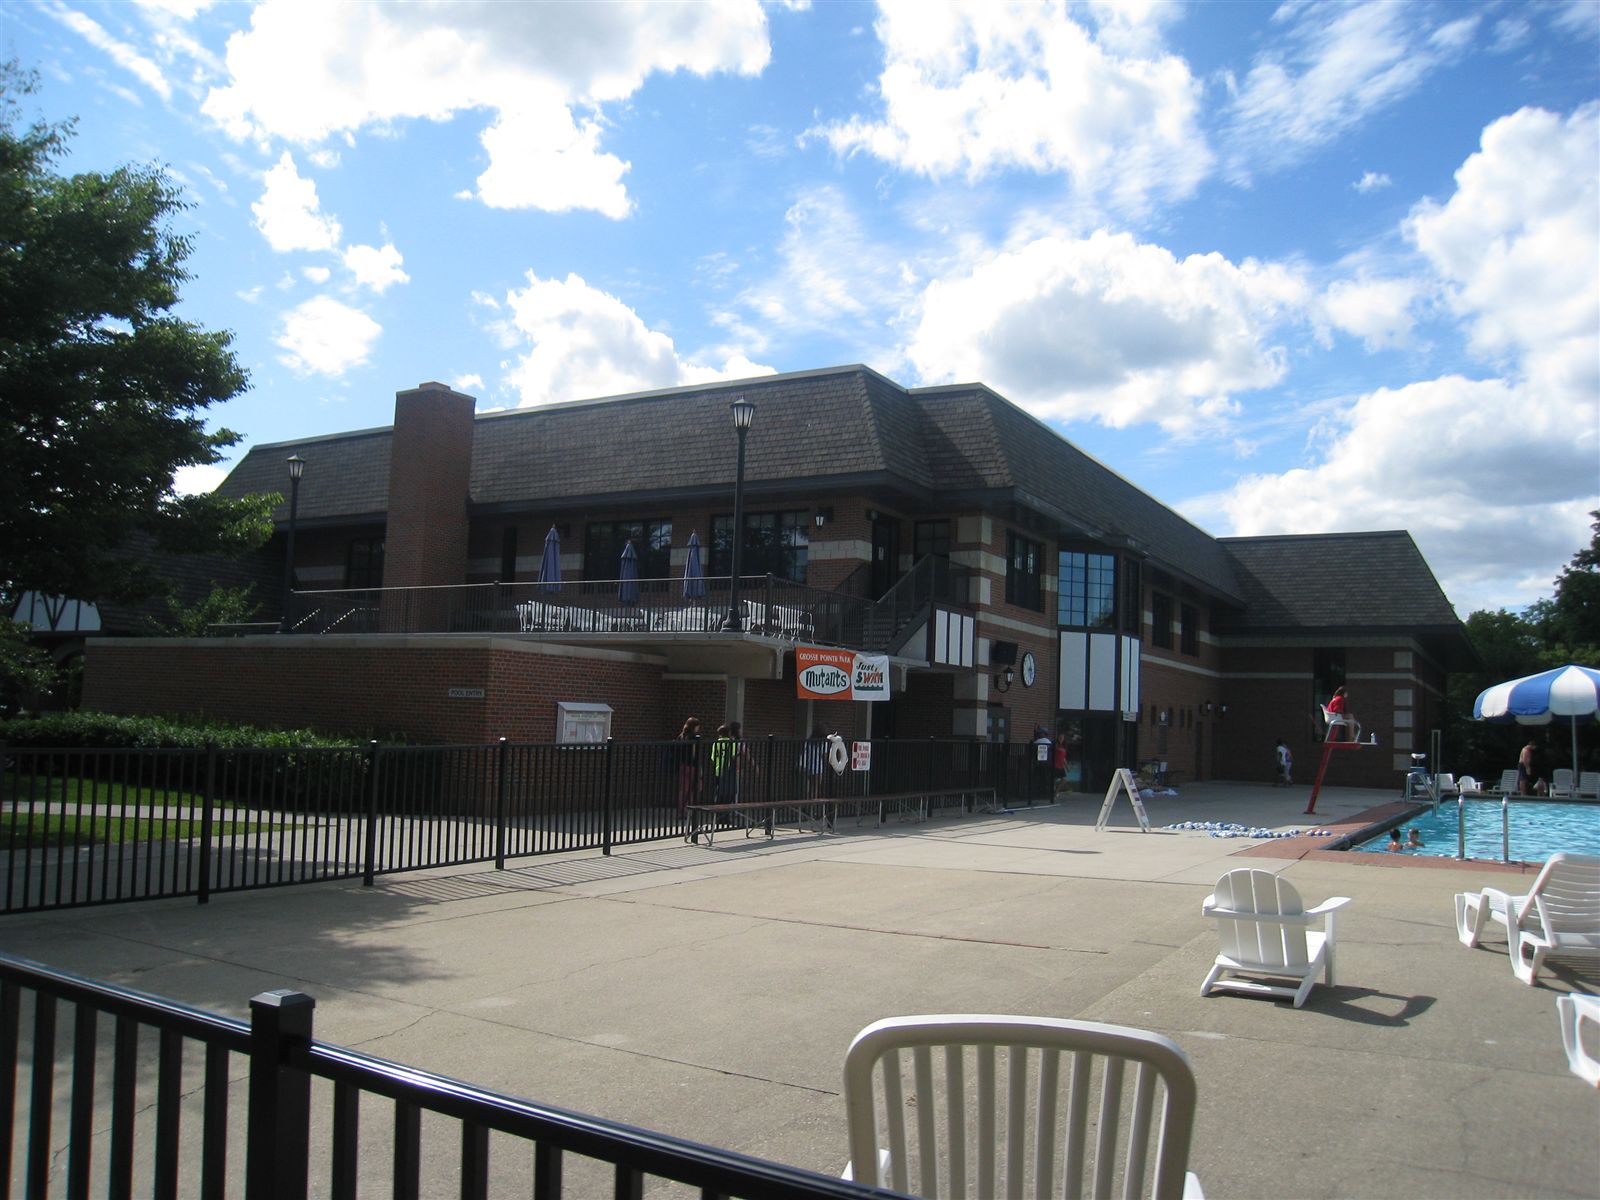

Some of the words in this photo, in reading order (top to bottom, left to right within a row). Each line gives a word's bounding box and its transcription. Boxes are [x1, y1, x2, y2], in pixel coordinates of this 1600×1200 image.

[799, 653, 818, 661] GROSSE
[820, 654, 838, 662] POINTE
[856, 662, 874, 671] Just
[856, 672, 884, 684] SWIM
